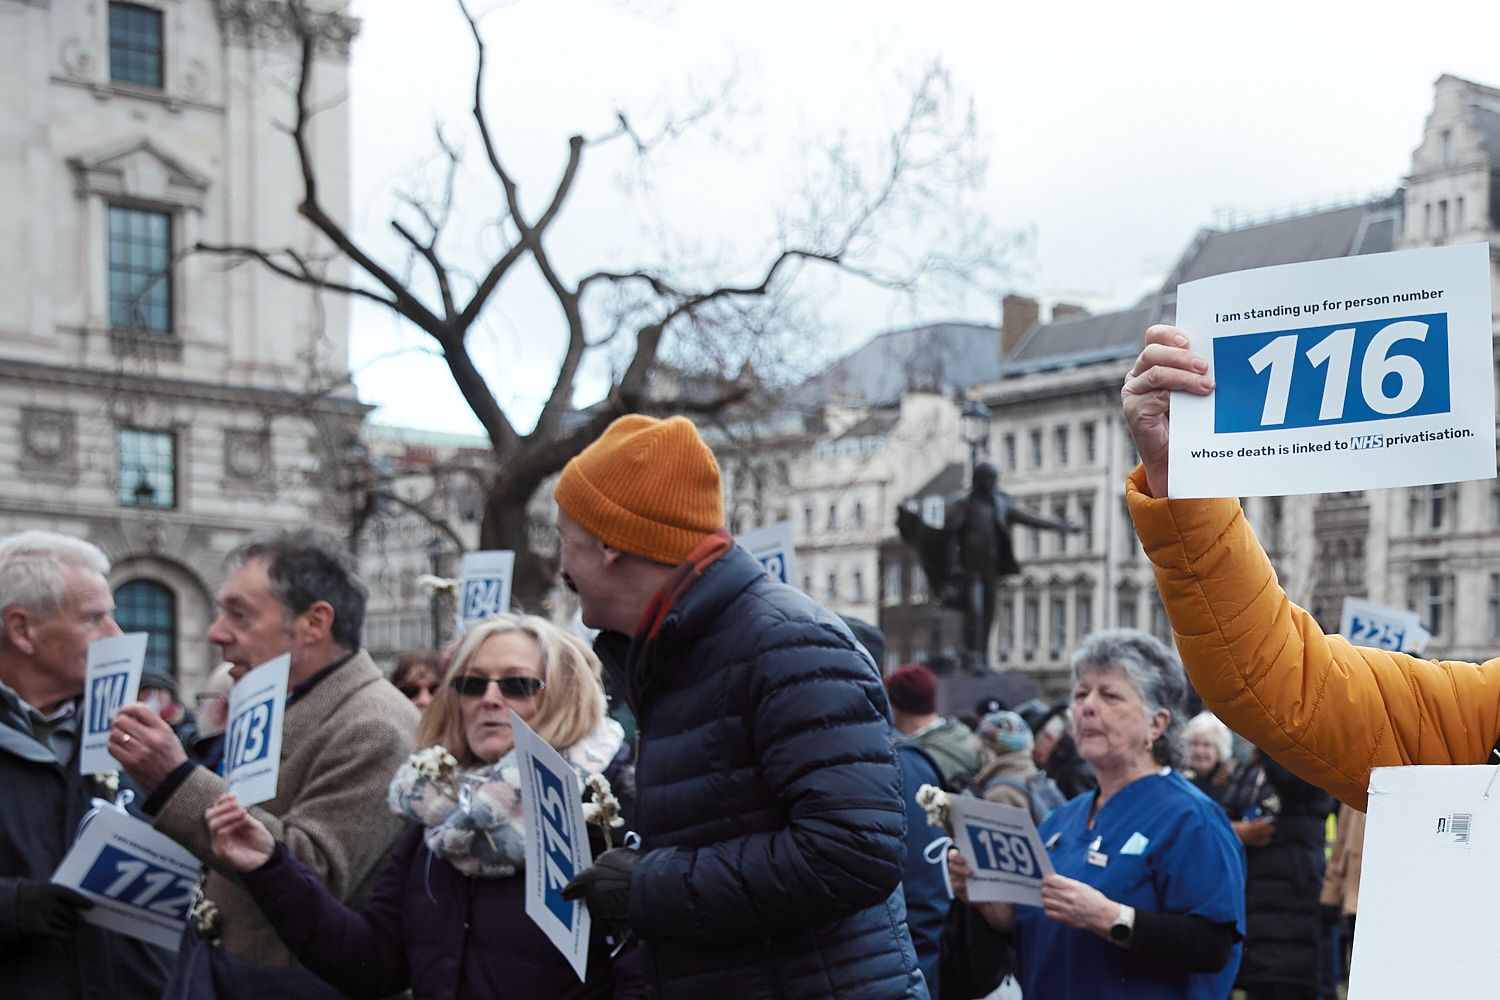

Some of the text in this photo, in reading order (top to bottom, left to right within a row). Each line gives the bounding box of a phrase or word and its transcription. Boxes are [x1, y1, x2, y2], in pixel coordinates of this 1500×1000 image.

[1215, 289, 1445, 323] I am standing up for person number
[1248, 320, 1430, 426] 116
[1190, 427, 1475, 459] whose death is linked to NHS privatisation.
[977, 829, 1034, 876] 139
[104, 859, 199, 916] 112
